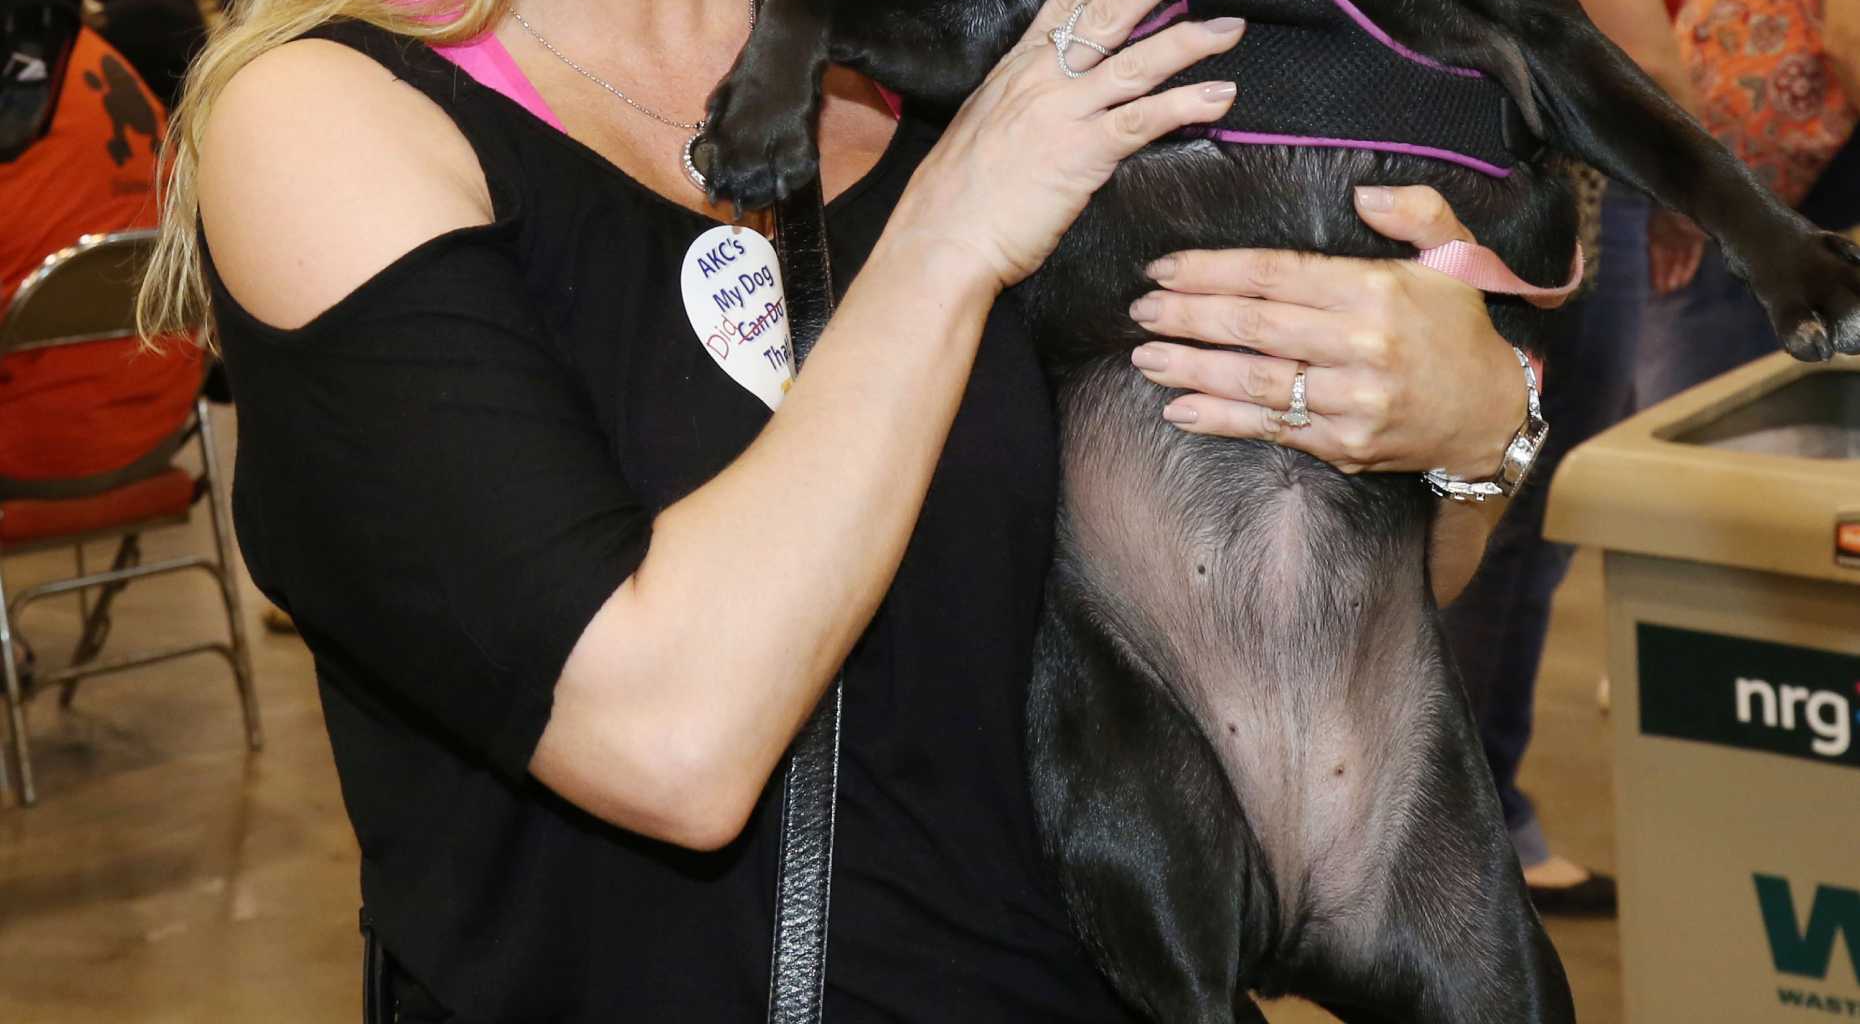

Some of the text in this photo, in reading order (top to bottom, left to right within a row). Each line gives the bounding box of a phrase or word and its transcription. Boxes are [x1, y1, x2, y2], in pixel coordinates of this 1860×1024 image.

[697, 238, 745, 278] AKC's
[712, 265, 774, 313] My Dog
[706, 314, 739, 360] Did
[738, 315, 770, 341] Can
[1735, 677, 1851, 756] nrg
